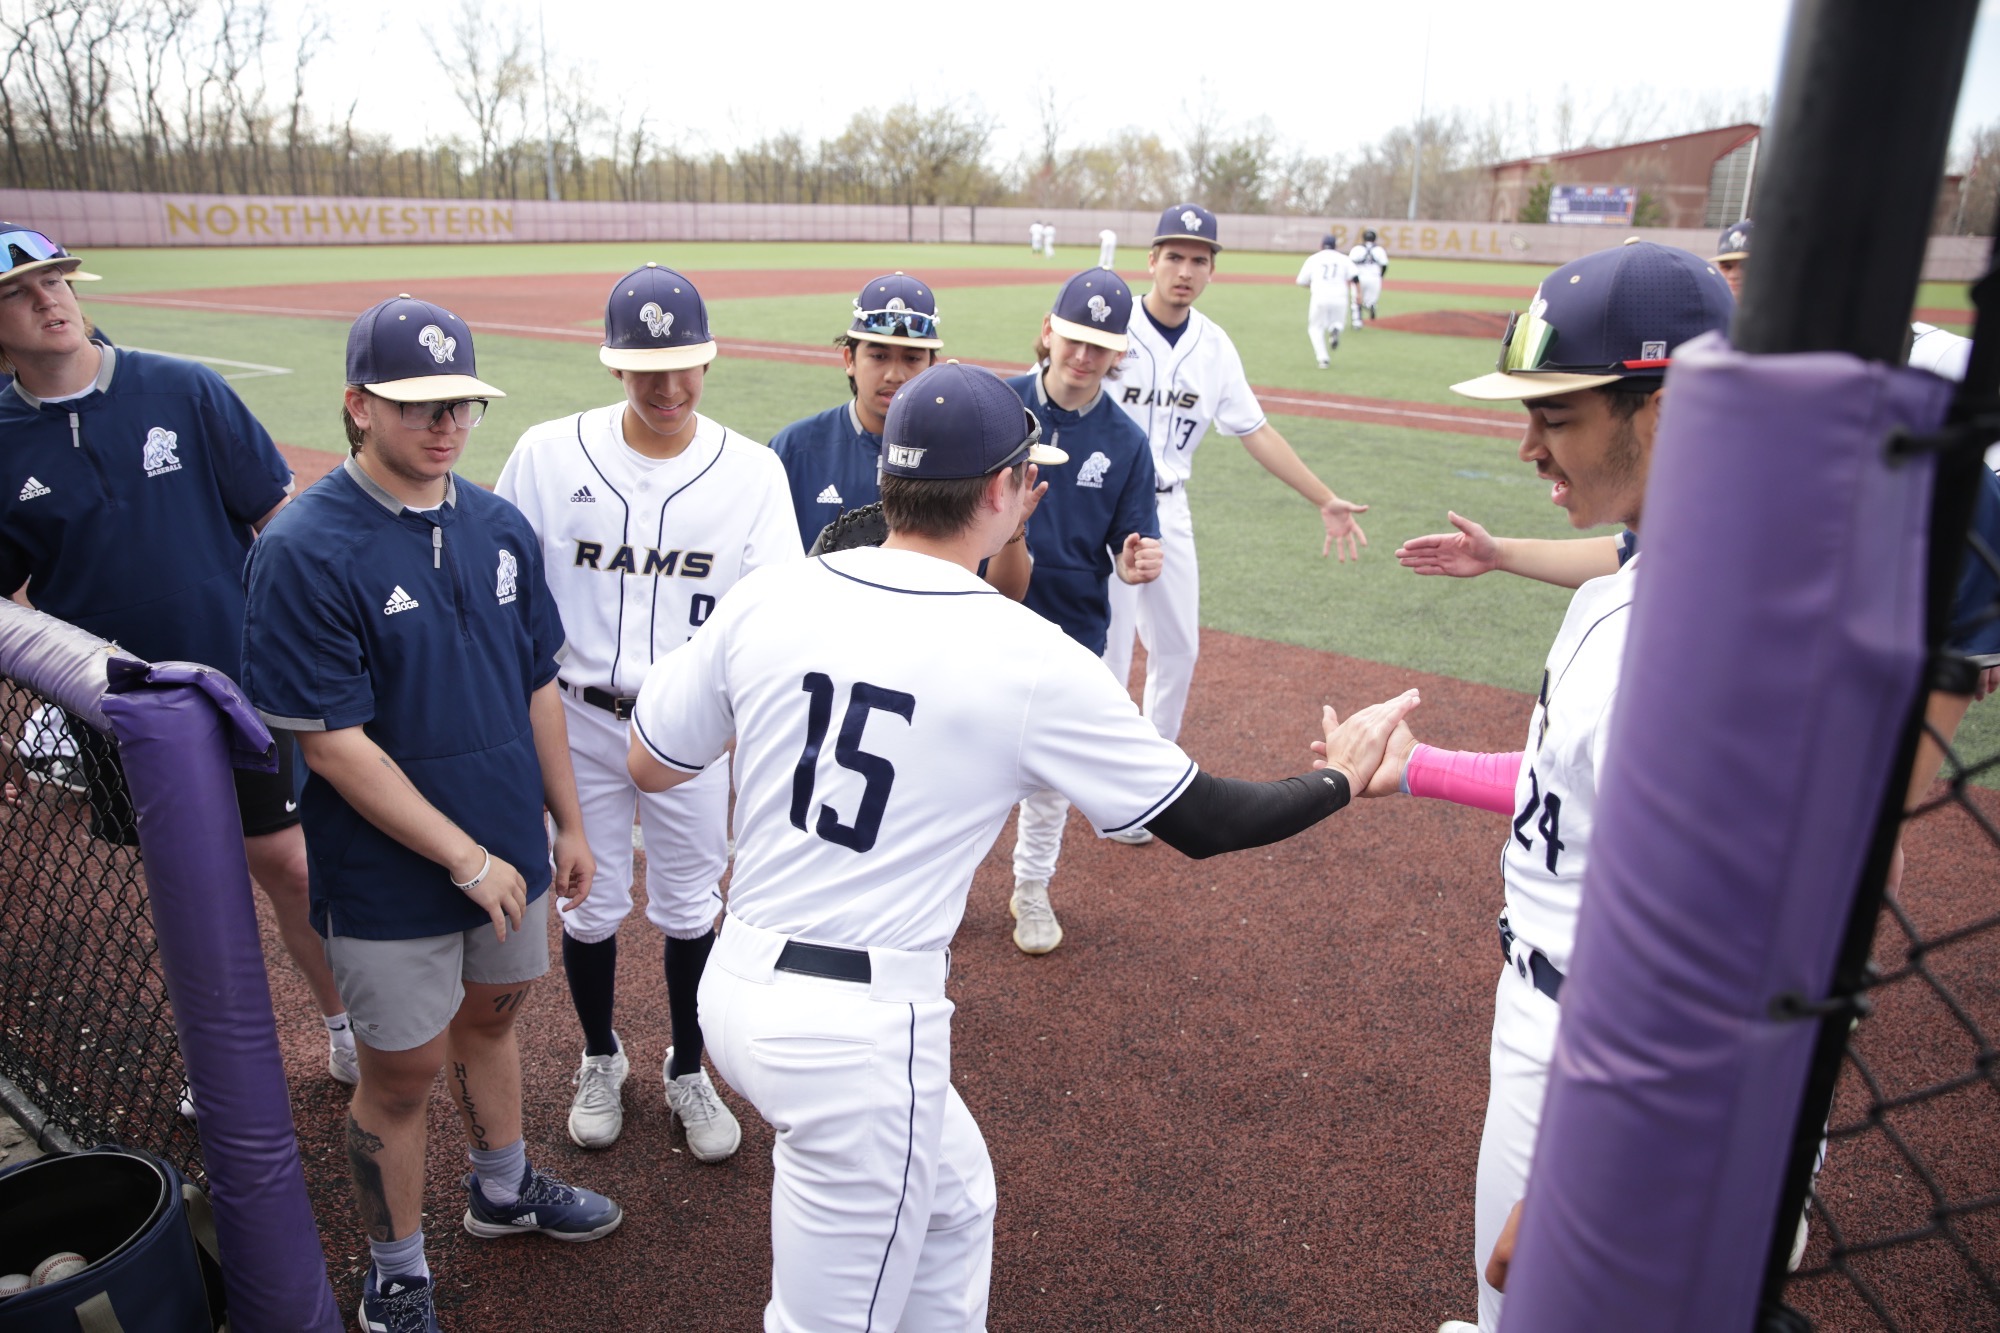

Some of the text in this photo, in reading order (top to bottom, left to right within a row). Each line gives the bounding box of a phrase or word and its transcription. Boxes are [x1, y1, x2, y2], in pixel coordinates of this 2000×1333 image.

[166, 202, 514, 236] NORTHWESTERN
[1175, 416, 1198, 450] 13
[147, 463, 182, 478] BASEBALL
[888, 443, 928, 469] NCU
[19, 486, 51, 501] adidas
[570, 495, 596, 503] adidas
[572, 538, 715, 580] RAMS
[383, 599, 419, 615] adidas
[790, 672, 916, 853] 15
[1513, 763, 1565, 877] 24
